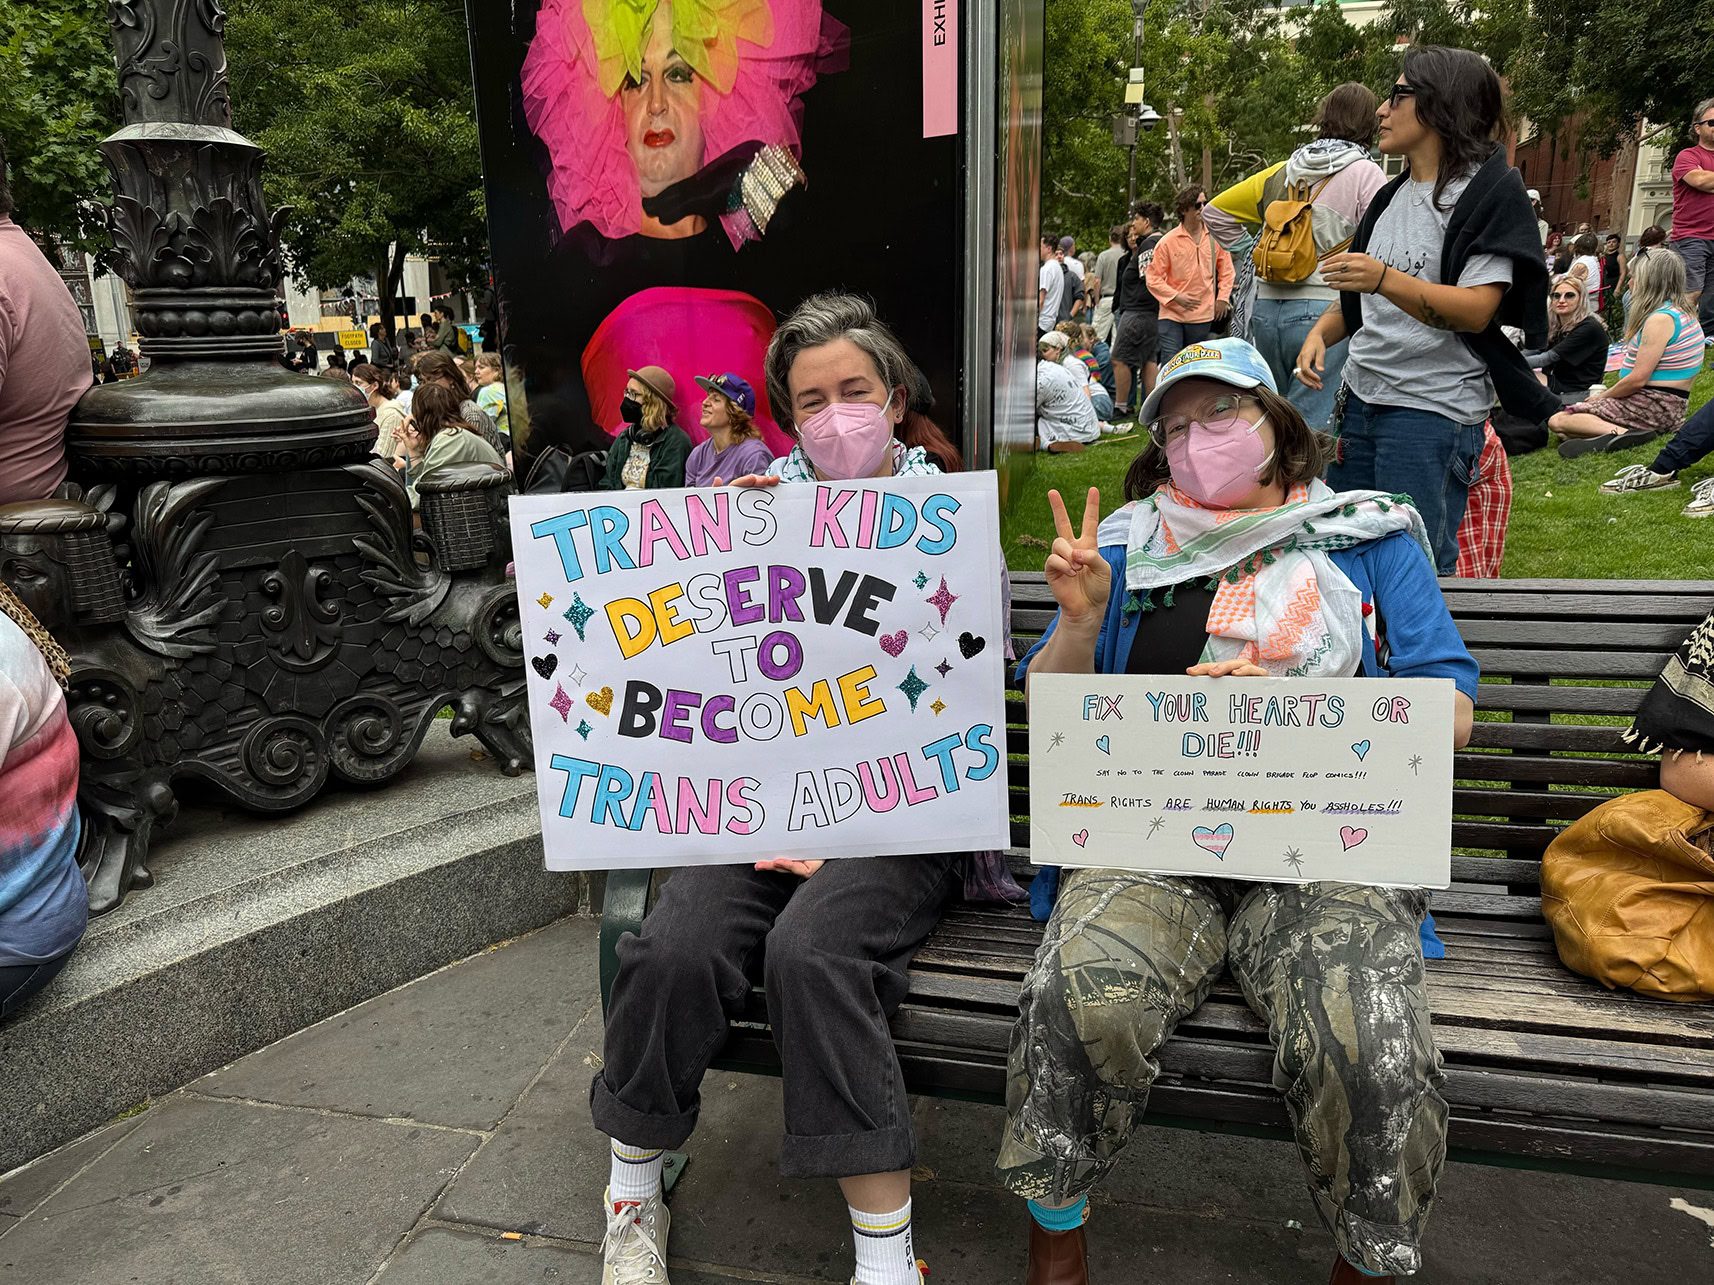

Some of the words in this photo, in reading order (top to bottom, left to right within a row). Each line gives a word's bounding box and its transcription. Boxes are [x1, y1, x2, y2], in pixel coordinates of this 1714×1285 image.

[531, 489, 778, 582] TRANS
[809, 486, 962, 555] KIDS
[604, 565, 897, 660] DESERVE
[712, 631, 804, 683] TO
[617, 664, 886, 743] BECOME
[1082, 694, 1124, 721] FIX
[1145, 691, 1209, 722] YOUR
[1229, 693, 1345, 728] HEARTS
[1371, 696, 1411, 724] OR
[1182, 730, 1261, 758] DIE!!!
[549, 753, 766, 834] TRANS
[787, 724, 1000, 831] ADULTS
[1062, 793, 1098, 804] TRANS
[1110, 796, 1152, 808] RIGHTS
[1165, 798, 1191, 808] ARE
[1206, 798, 1245, 809] HUMAN
[1252, 800, 1292, 810] RIGHTS
[1300, 800, 1316, 811] YOU
[1326, 800, 1402, 812] ASSHOLES!!!
